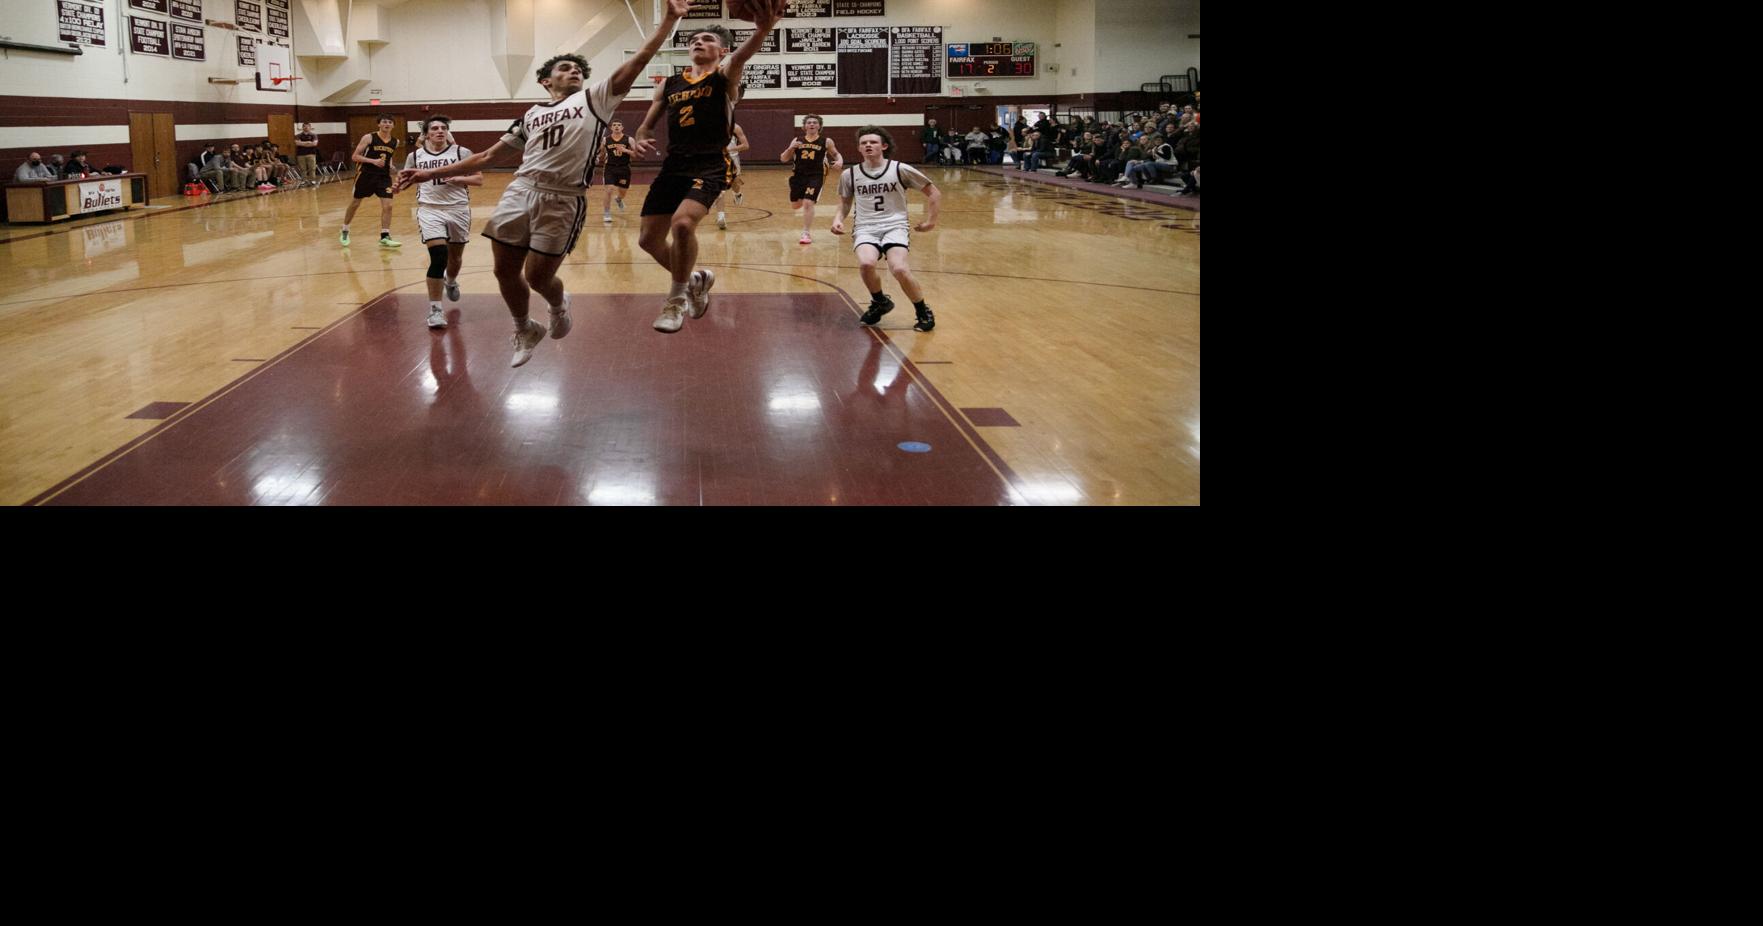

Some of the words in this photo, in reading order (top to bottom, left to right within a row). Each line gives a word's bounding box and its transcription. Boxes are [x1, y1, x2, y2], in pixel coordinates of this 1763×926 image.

[986, 44, 1010, 54] 1:06
[987, 64, 995, 74] 2
[1014, 63, 1032, 74] 30
[679, 104, 696, 127] 2
[542, 124, 565, 151] 10
[801, 150, 816, 160] 24
[856, 181, 898, 195] FAIRFAX
[84, 192, 121, 209] Bullets
[873, 195, 885, 212] 2
